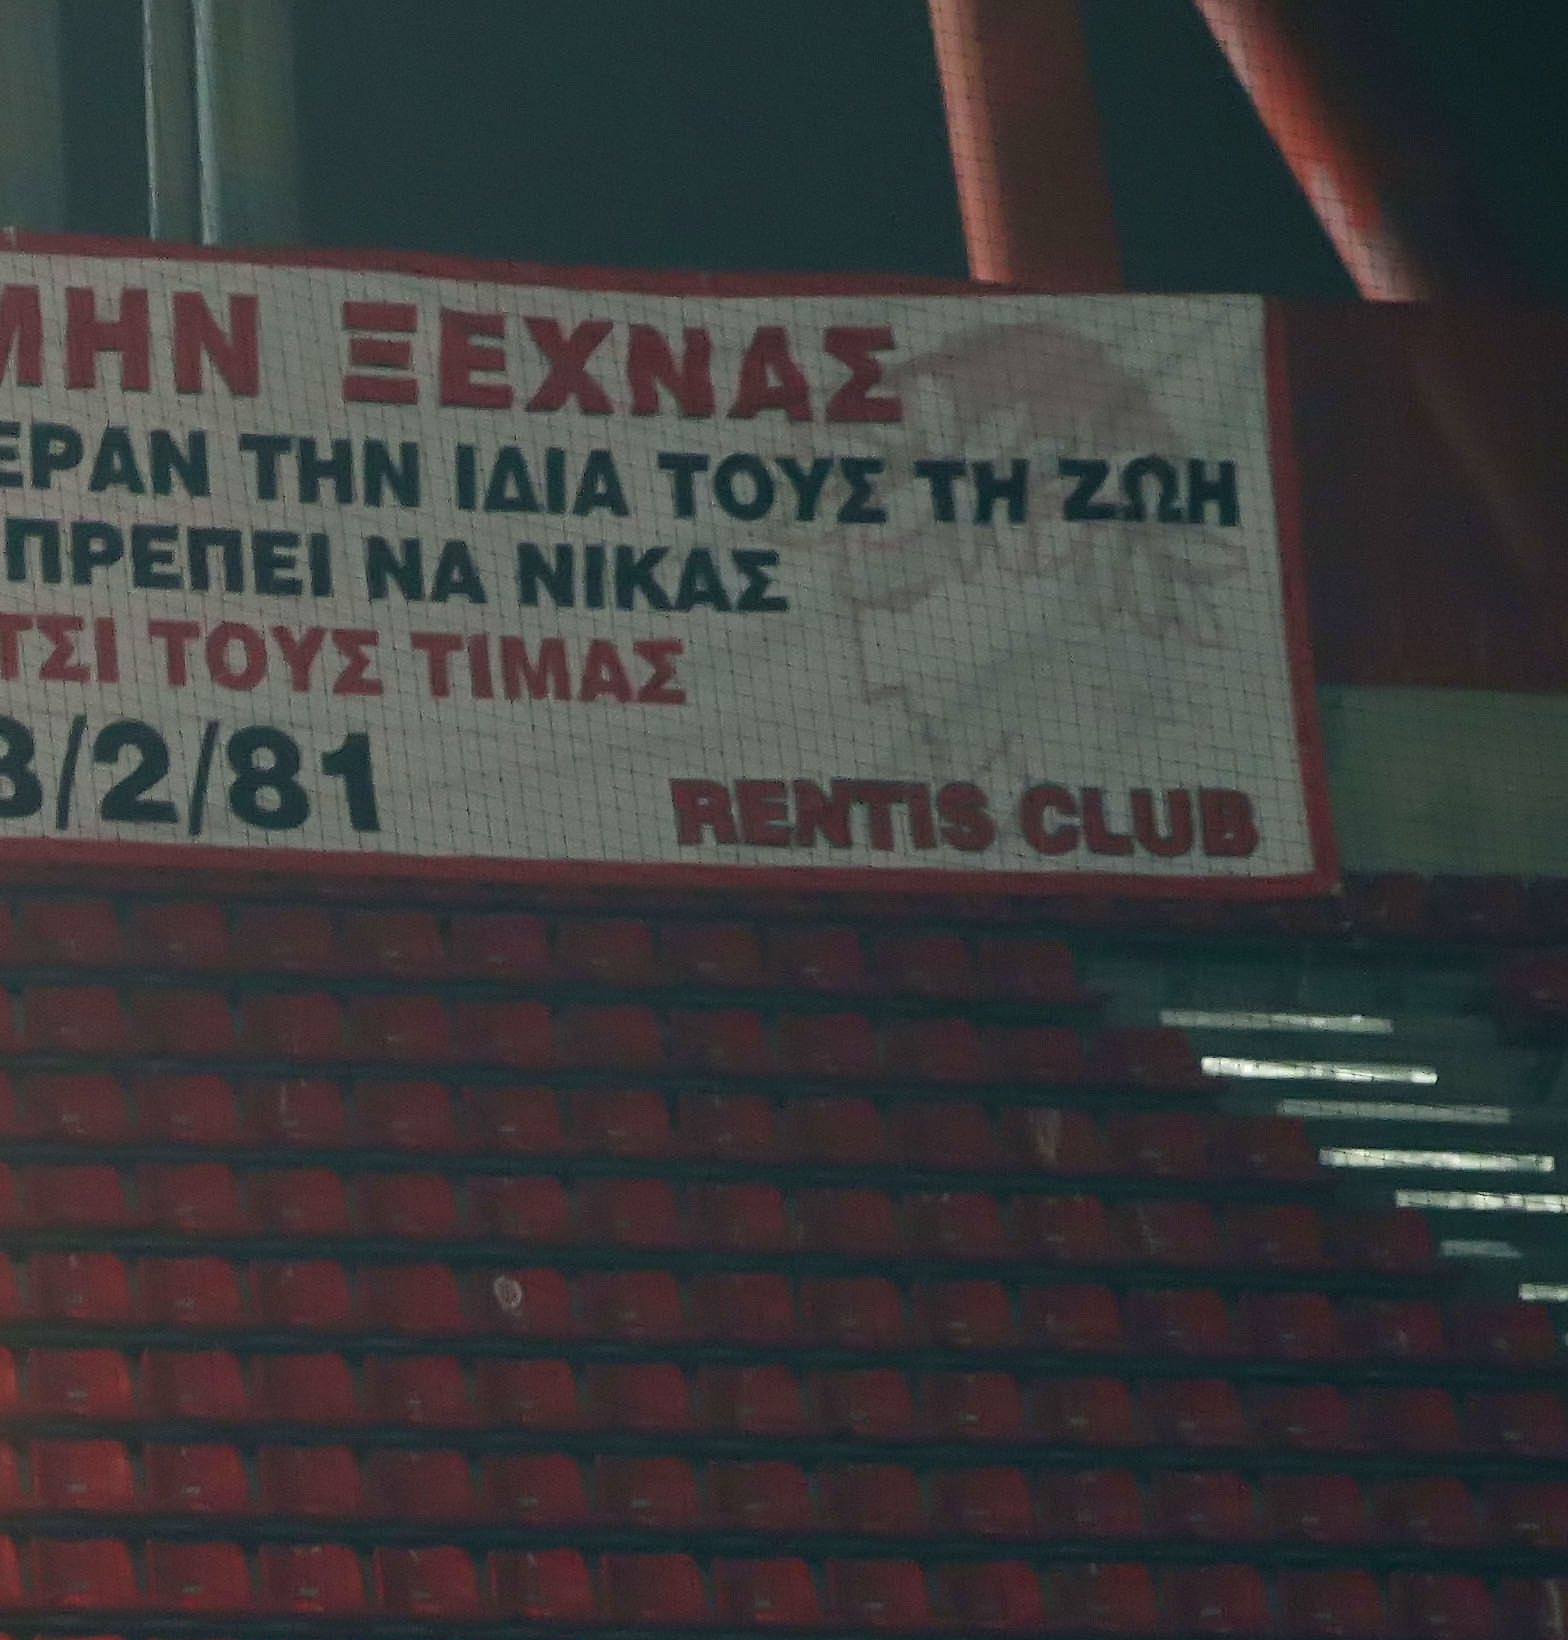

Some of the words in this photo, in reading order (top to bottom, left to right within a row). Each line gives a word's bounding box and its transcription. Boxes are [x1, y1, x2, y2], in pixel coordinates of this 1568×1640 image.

[343, 301, 903, 424] ΞΕΧΝΑΣ
[240, 434, 420, 508] ΤΗΝ
[457, 443, 630, 517] ΙΔΙΑ
[657, 453, 887, 523] ΤΟΥΣ
[915, 460, 1029, 526] ΤΗ
[1058, 455, 1240, 528] ΖΩΗ
[4, 517, 332, 598] ΠΡΕΠΕΙ
[365, 536, 488, 603] ΝΑ
[518, 542, 789, 612] ΝΙΚΑΣ
[148, 619, 384, 698] ΤΟΥΣ
[411, 631, 687, 706] ΤΙΜΑΣ
[669, 778, 996, 854] RENTIS
[1020, 786, 1260, 858] CLUB
